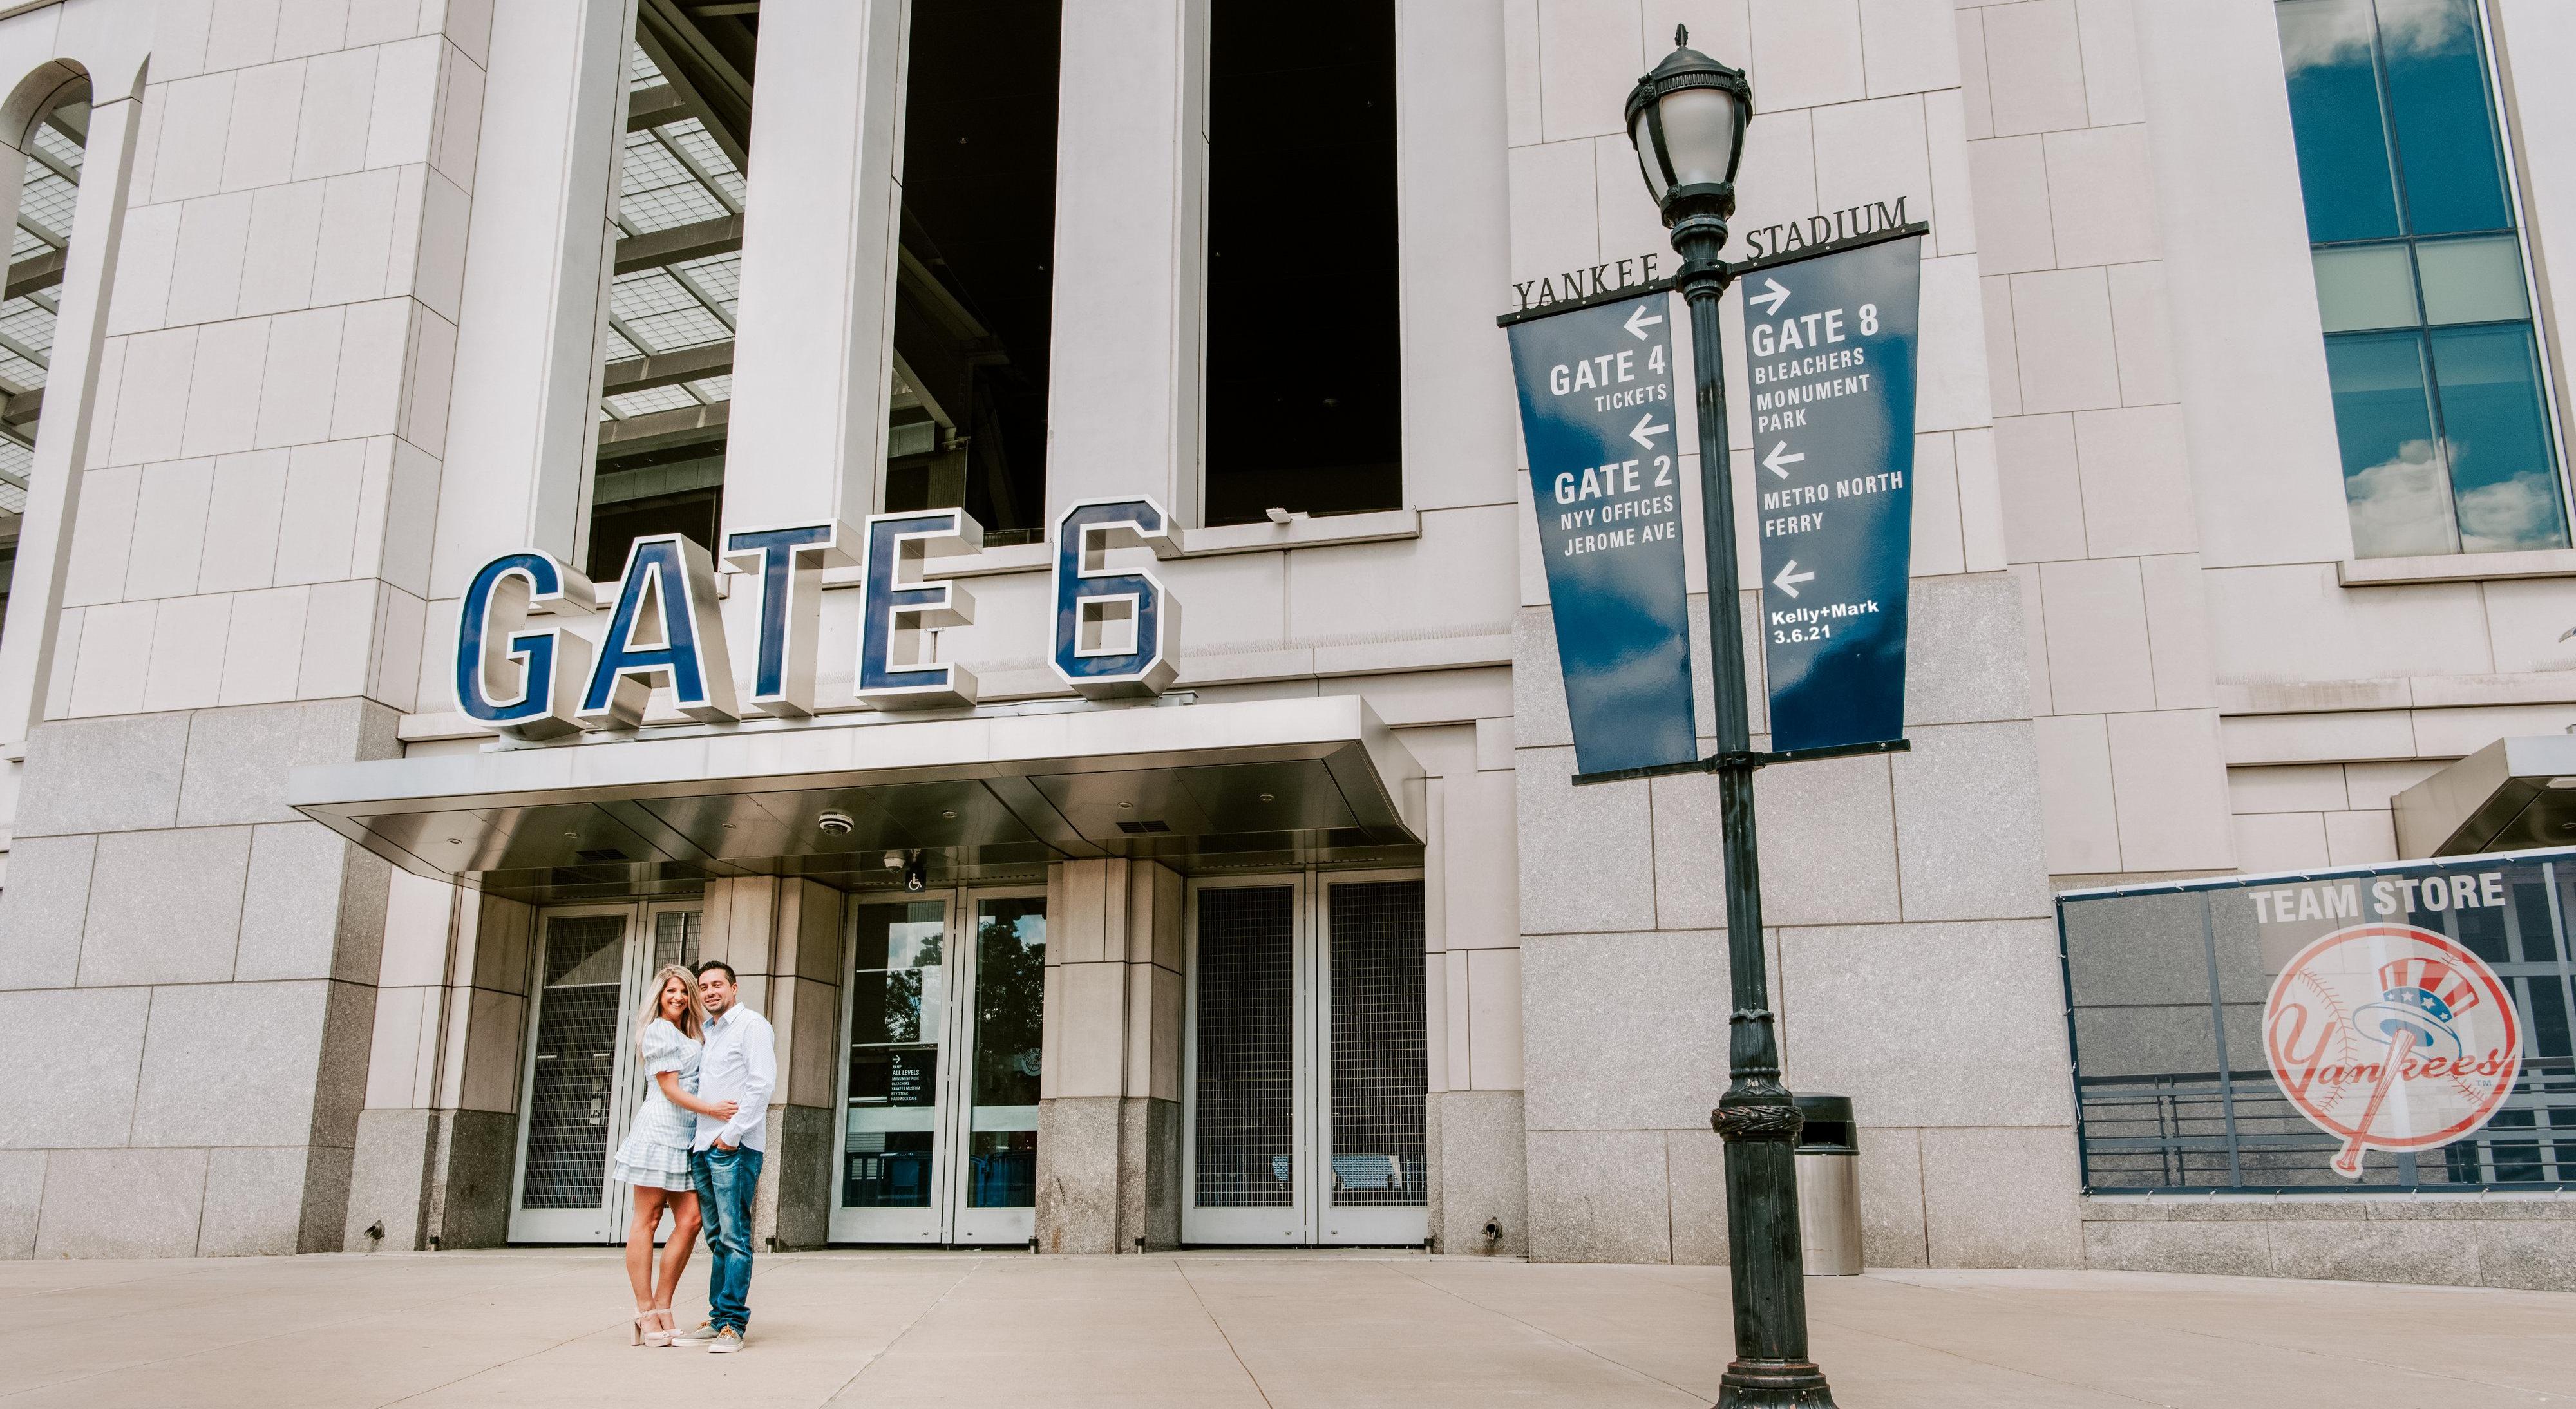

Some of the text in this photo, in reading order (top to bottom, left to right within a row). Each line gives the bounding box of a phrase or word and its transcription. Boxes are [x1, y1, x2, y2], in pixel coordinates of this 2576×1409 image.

[1513, 196, 1909, 310] YANKEE STADIUM
[1752, 303, 1879, 357] GATE 8
[1550, 345, 1665, 395] GATE 4
[1755, 347, 1864, 384] BLEACHERS
[1595, 383, 1667, 412] TICKETS
[1757, 374, 1870, 411] MONUMENT
[1759, 408, 1807, 433] PARK
[1555, 455, 1672, 505] GATE 2
[1764, 471, 1903, 511] METRO NORTH
[1561, 495, 1674, 531] NYY OFFICES
[1765, 512, 1823, 537] FERRY
[1564, 521, 1676, 556] JEROME AVE
[452, 495, 1171, 732] GATE 6
[2249, 872, 2506, 923] TEAM STORE
[2269, 1003, 2507, 1095] Yankees
